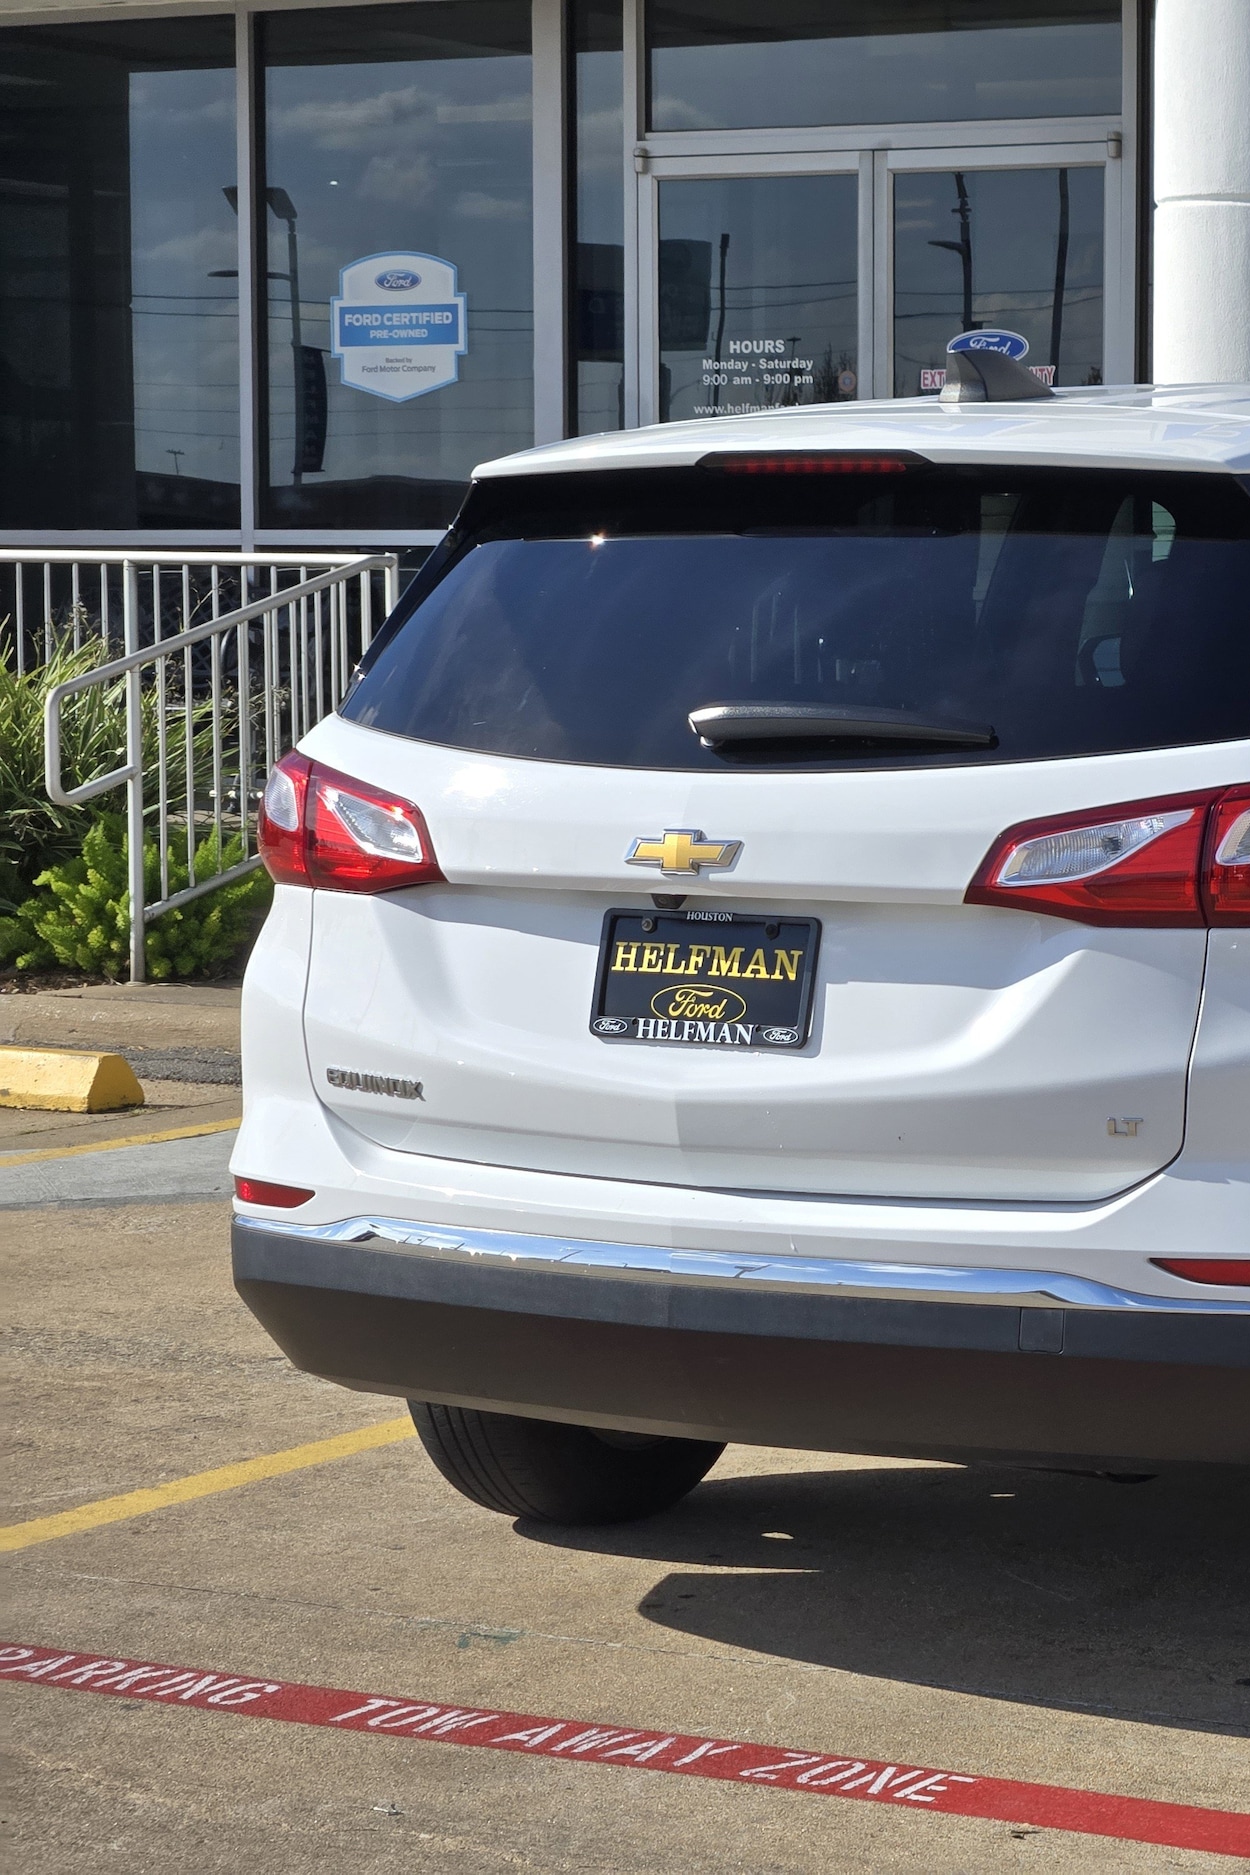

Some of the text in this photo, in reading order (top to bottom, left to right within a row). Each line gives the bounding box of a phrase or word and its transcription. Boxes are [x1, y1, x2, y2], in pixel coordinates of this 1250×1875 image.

[384, 273, 412, 287] Ford
[344, 312, 452, 326] FORD CERTIFIED
[370, 329, 428, 339] PRE-OWNED
[729, 340, 785, 354] HOURS
[380, 365, 401, 373] Motor
[402, 365, 436, 373] Company
[702, 359, 748, 372] Monday
[759, 358, 813, 371] Saturday
[702, 374, 728, 385] 9:00
[732, 376, 752, 385] am
[763, 374, 791, 384] 9:00
[794, 375, 814, 386] pm
[686, 911, 733, 922] HOUSTON
[611, 941, 803, 981] HELFMAN
[668, 988, 728, 1019] Ford
[599, 1018, 622, 1032] Ford
[636, 1017, 755, 1045] HELFMAN
[769, 1029, 794, 1042] Ford
[1106, 1117, 1144, 1137] LT
[330, 1698, 500, 1736] TOW
[490, 1723, 741, 1768] AWAY
[740, 1753, 976, 1802] ZONE
